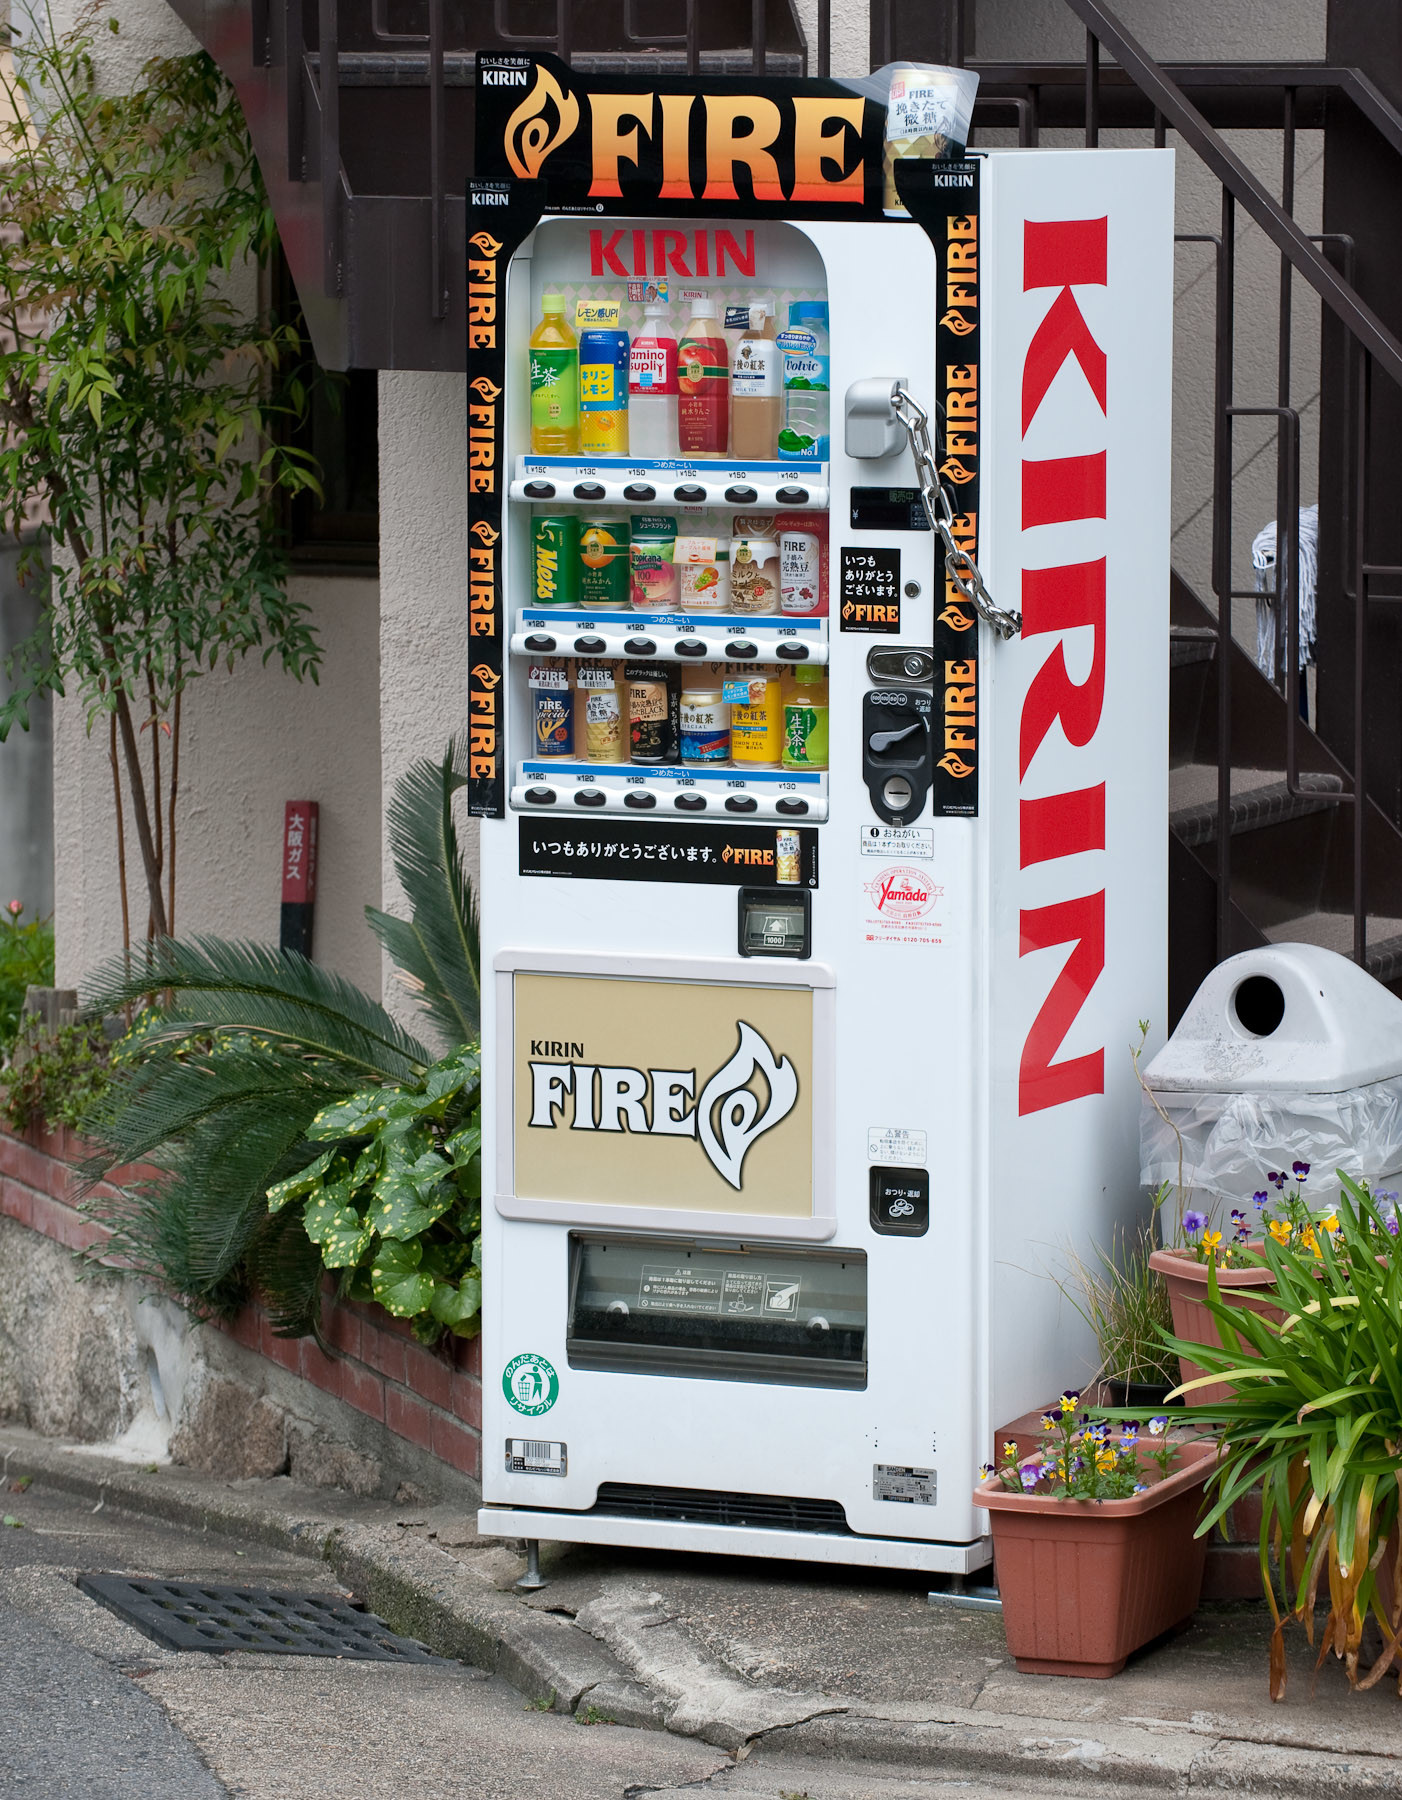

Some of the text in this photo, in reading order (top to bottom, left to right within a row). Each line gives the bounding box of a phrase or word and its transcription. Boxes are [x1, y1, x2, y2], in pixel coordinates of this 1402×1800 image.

[480, 57, 530, 65] おいしさを笑顔に
[482, 71, 527, 86] KIRIN
[909, 89, 934, 99] FIRE
[896, 100, 947, 116] 挽きたて
[904, 111, 937, 127] 微糖
[586, 92, 866, 205] FIRE
[934, 174, 974, 187] KIRIN
[472, 193, 509, 206] KIRIN
[589, 229, 756, 277] KIRIN
[946, 214, 978, 308] FIRE
[468, 259, 496, 349] FIRE
[630, 350, 665, 360] amino
[531, 359, 560, 388] 生茶
[630, 360, 657, 372] supli
[786, 360, 818, 371] Volvic
[582, 370, 610, 381] キリン
[582, 384, 610, 395] レモン
[946, 364, 977, 456] FIRE
[469, 403, 496, 493] FIRE
[801, 440, 819, 456] No.1
[852, 508, 859, 520] ¥
[784, 541, 806, 551] FIRE
[631, 550, 662, 562] Tropicana
[845, 555, 876, 567] いつも
[536, 545, 558, 599] Mets
[845, 570, 894, 582] ありがとう
[469, 548, 496, 637] FIRE
[845, 584, 898, 598] ございます。
[855, 604, 899, 623] FIRE
[1019, 215, 1108, 1118] KIRIN
[540, 671, 567, 682] FIRE
[587, 670, 612, 681] FIRE
[630, 688, 647, 699] FIRE
[539, 700, 562, 710] FIRE
[944, 659, 976, 751] FIRE
[469, 690, 497, 779] FIRE
[790, 713, 805, 747] 生茶
[883, 829, 920, 839] おねがい
[286, 813, 304, 880] 大阪ガス
[533, 840, 774, 866] いつもありがとうございます。 FIRE
[877, 875, 928, 911] Yamada
[530, 1039, 584, 1058] KIRIN
[528, 1060, 698, 1142] FIRE
[505, 1354, 555, 1378] のんだあとは
[509, 1396, 553, 1415] リサイクル
